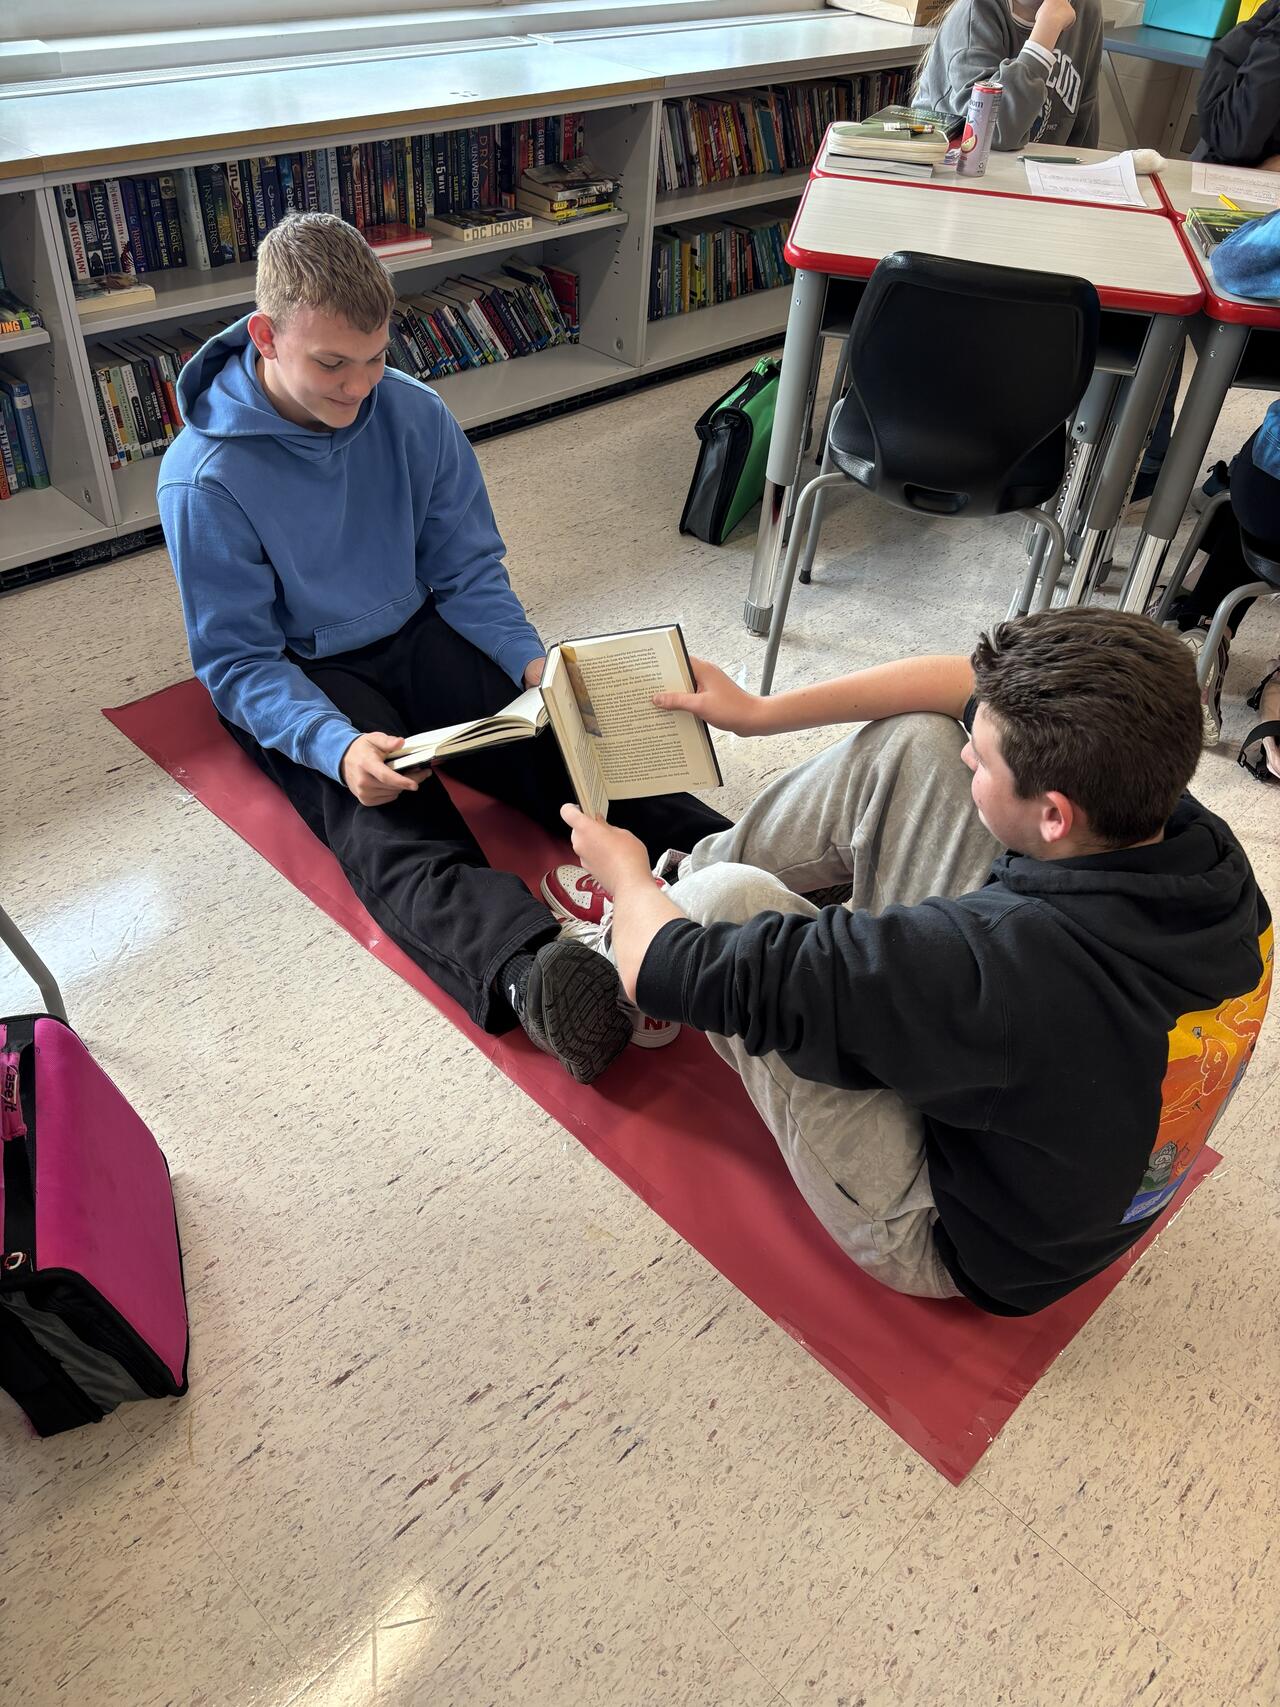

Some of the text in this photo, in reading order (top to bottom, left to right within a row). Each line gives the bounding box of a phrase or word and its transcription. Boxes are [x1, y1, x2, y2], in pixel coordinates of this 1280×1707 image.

[480, 136, 488, 169] DRY
[436, 166, 446, 174] 5
[255, 181, 267, 230] UNWIND
[168, 220, 180, 252] MAGIC
[471, 220, 525, 240] DC ICONS
[69, 221, 87, 275] INTERNMENT
[161, 249, 170, 266] GAME
